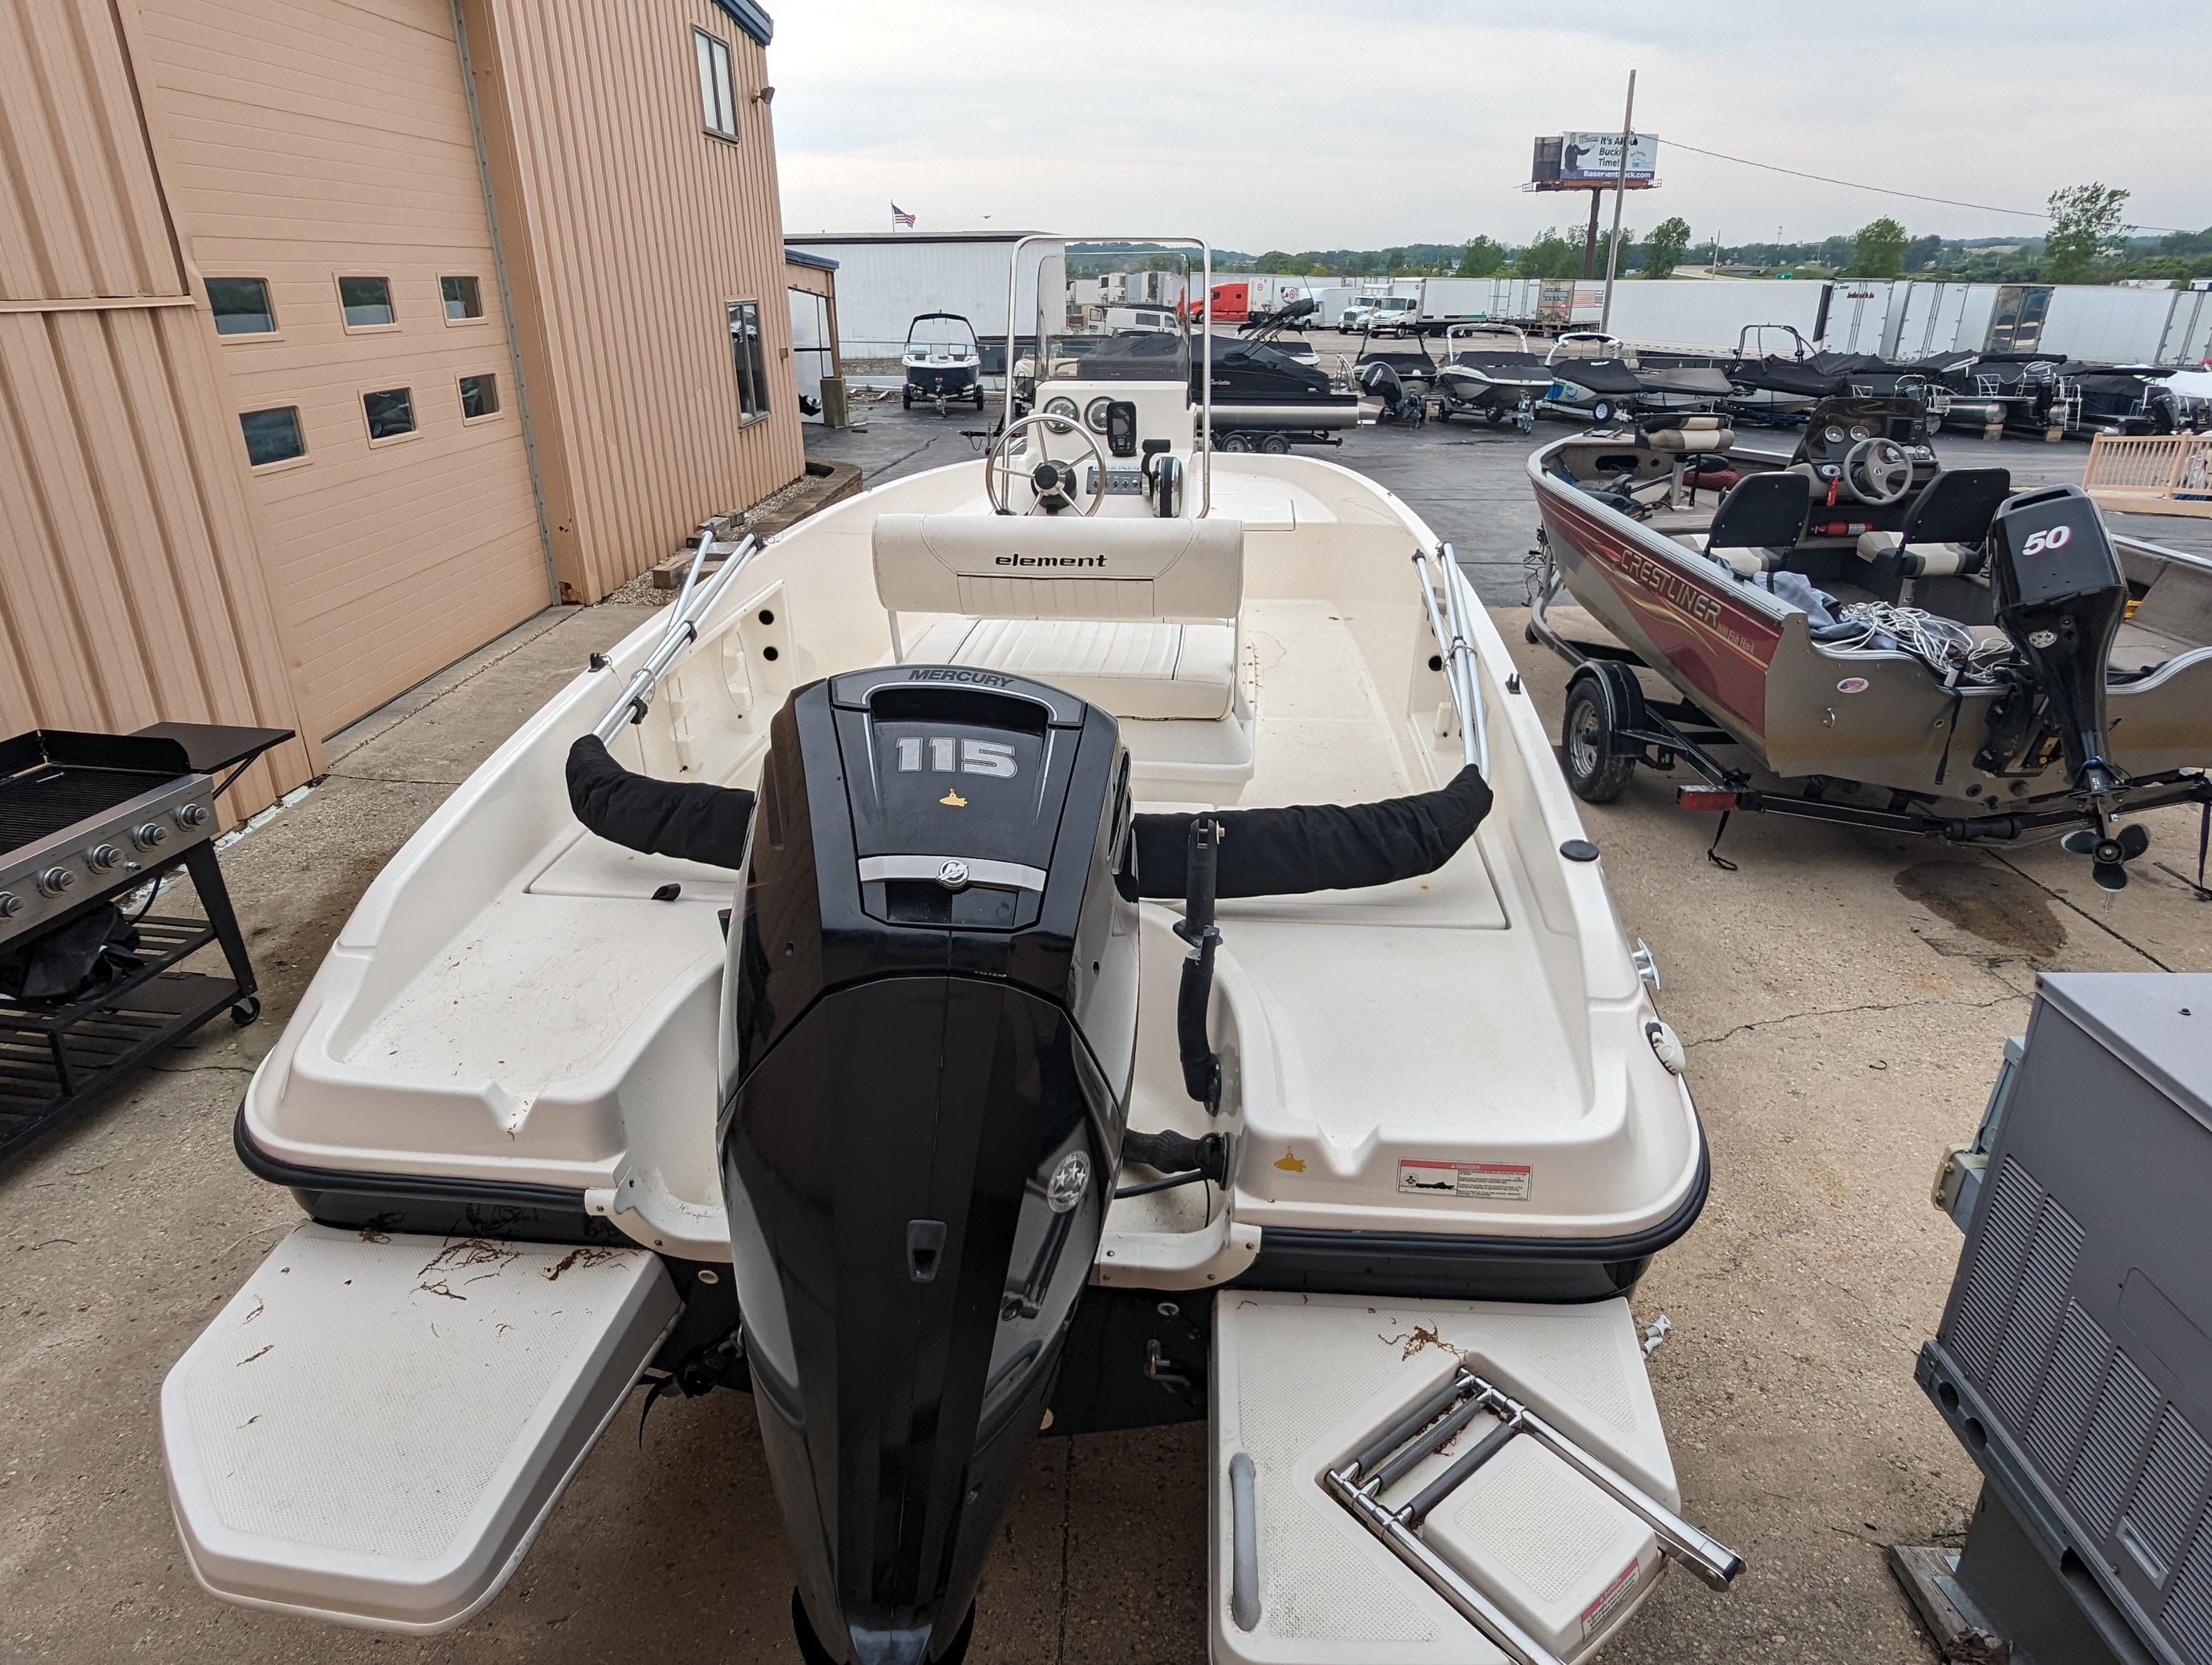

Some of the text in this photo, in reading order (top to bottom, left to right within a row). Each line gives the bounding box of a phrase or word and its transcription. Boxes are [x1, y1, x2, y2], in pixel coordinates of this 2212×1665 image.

[1600, 136, 1612, 145] It's
[1598, 158, 1620, 167] Time!
[2022, 525, 2072, 556] 50
[995, 553, 1109, 568] element
[1620, 549, 1722, 628] CRESTLINER
[1728, 630, 1739, 645] Fish
[1740, 637, 1755, 655] Hawk
[908, 669, 1016, 689] MERCURY
[896, 736, 1019, 779] 115
